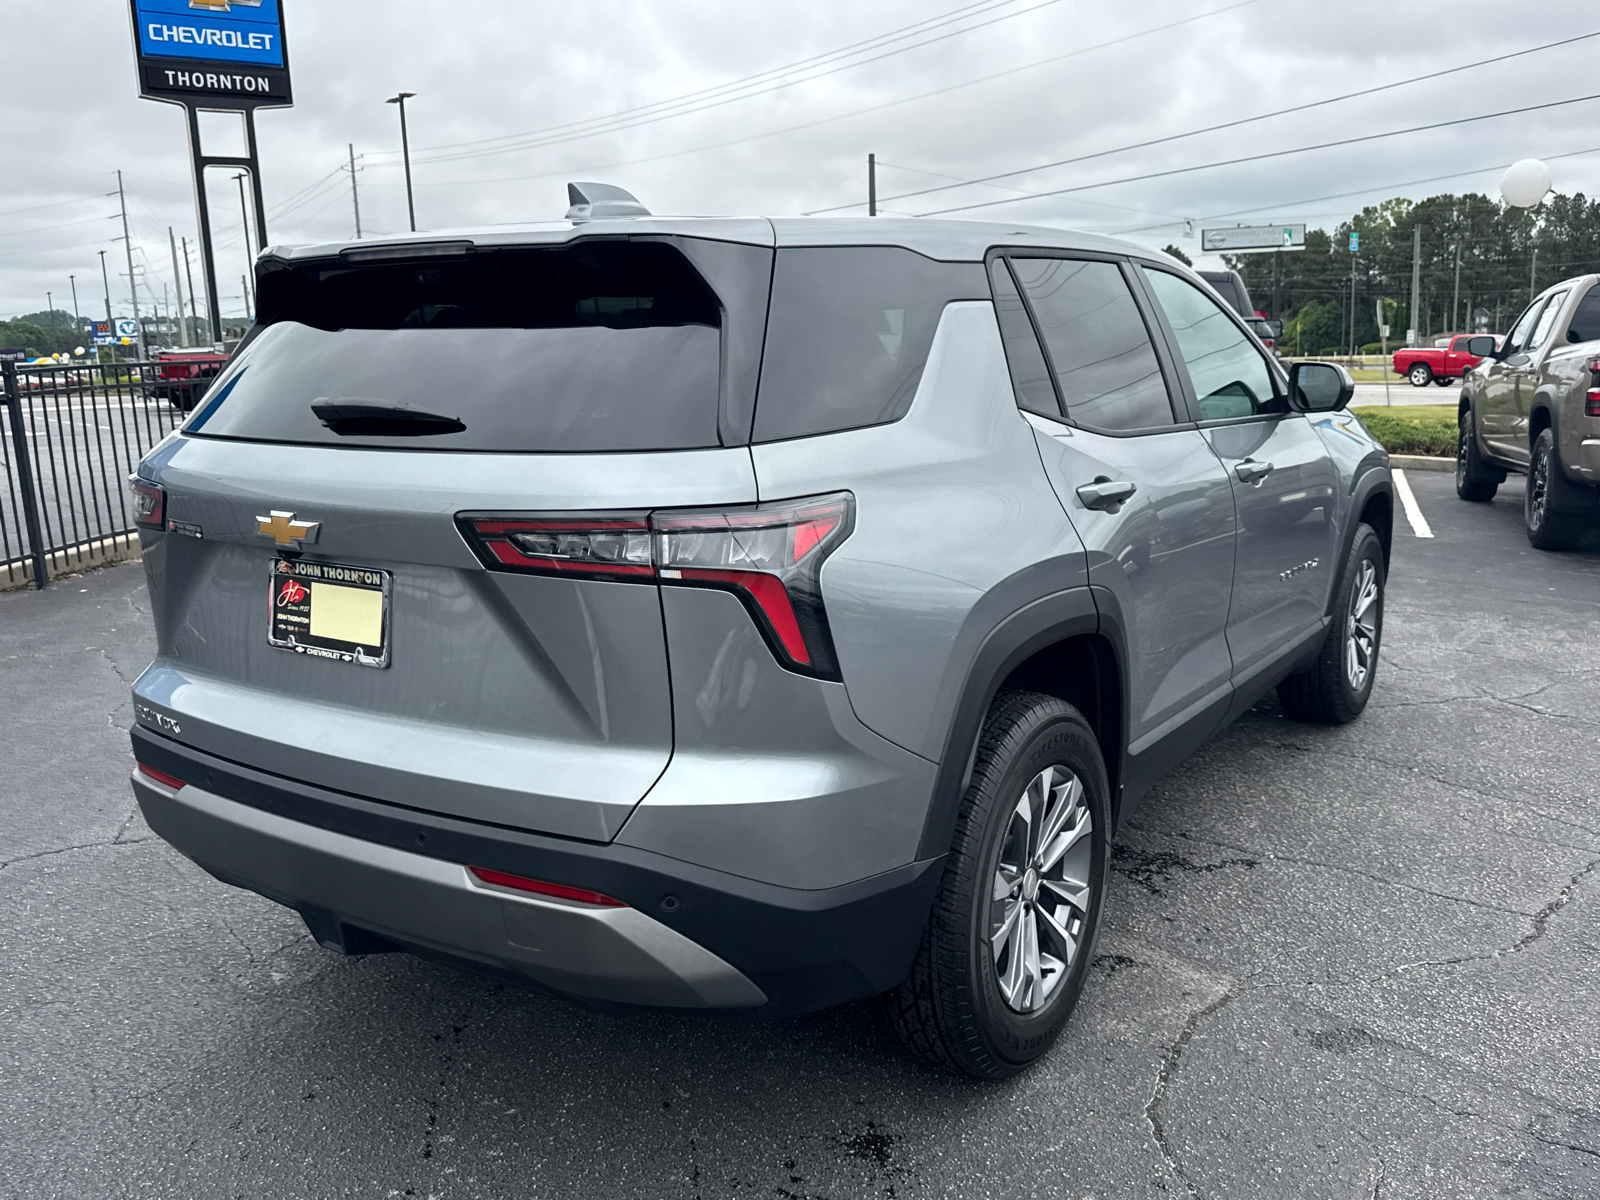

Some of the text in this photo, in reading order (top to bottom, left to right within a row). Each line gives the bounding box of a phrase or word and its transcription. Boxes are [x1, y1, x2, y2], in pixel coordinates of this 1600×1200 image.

[148, 23, 274, 50] CHEVROLET
[164, 70, 270, 93] THORNTON
[295, 562, 381, 585] JOHN THORNTON
[306, 648, 341, 660] CHEVROLET
